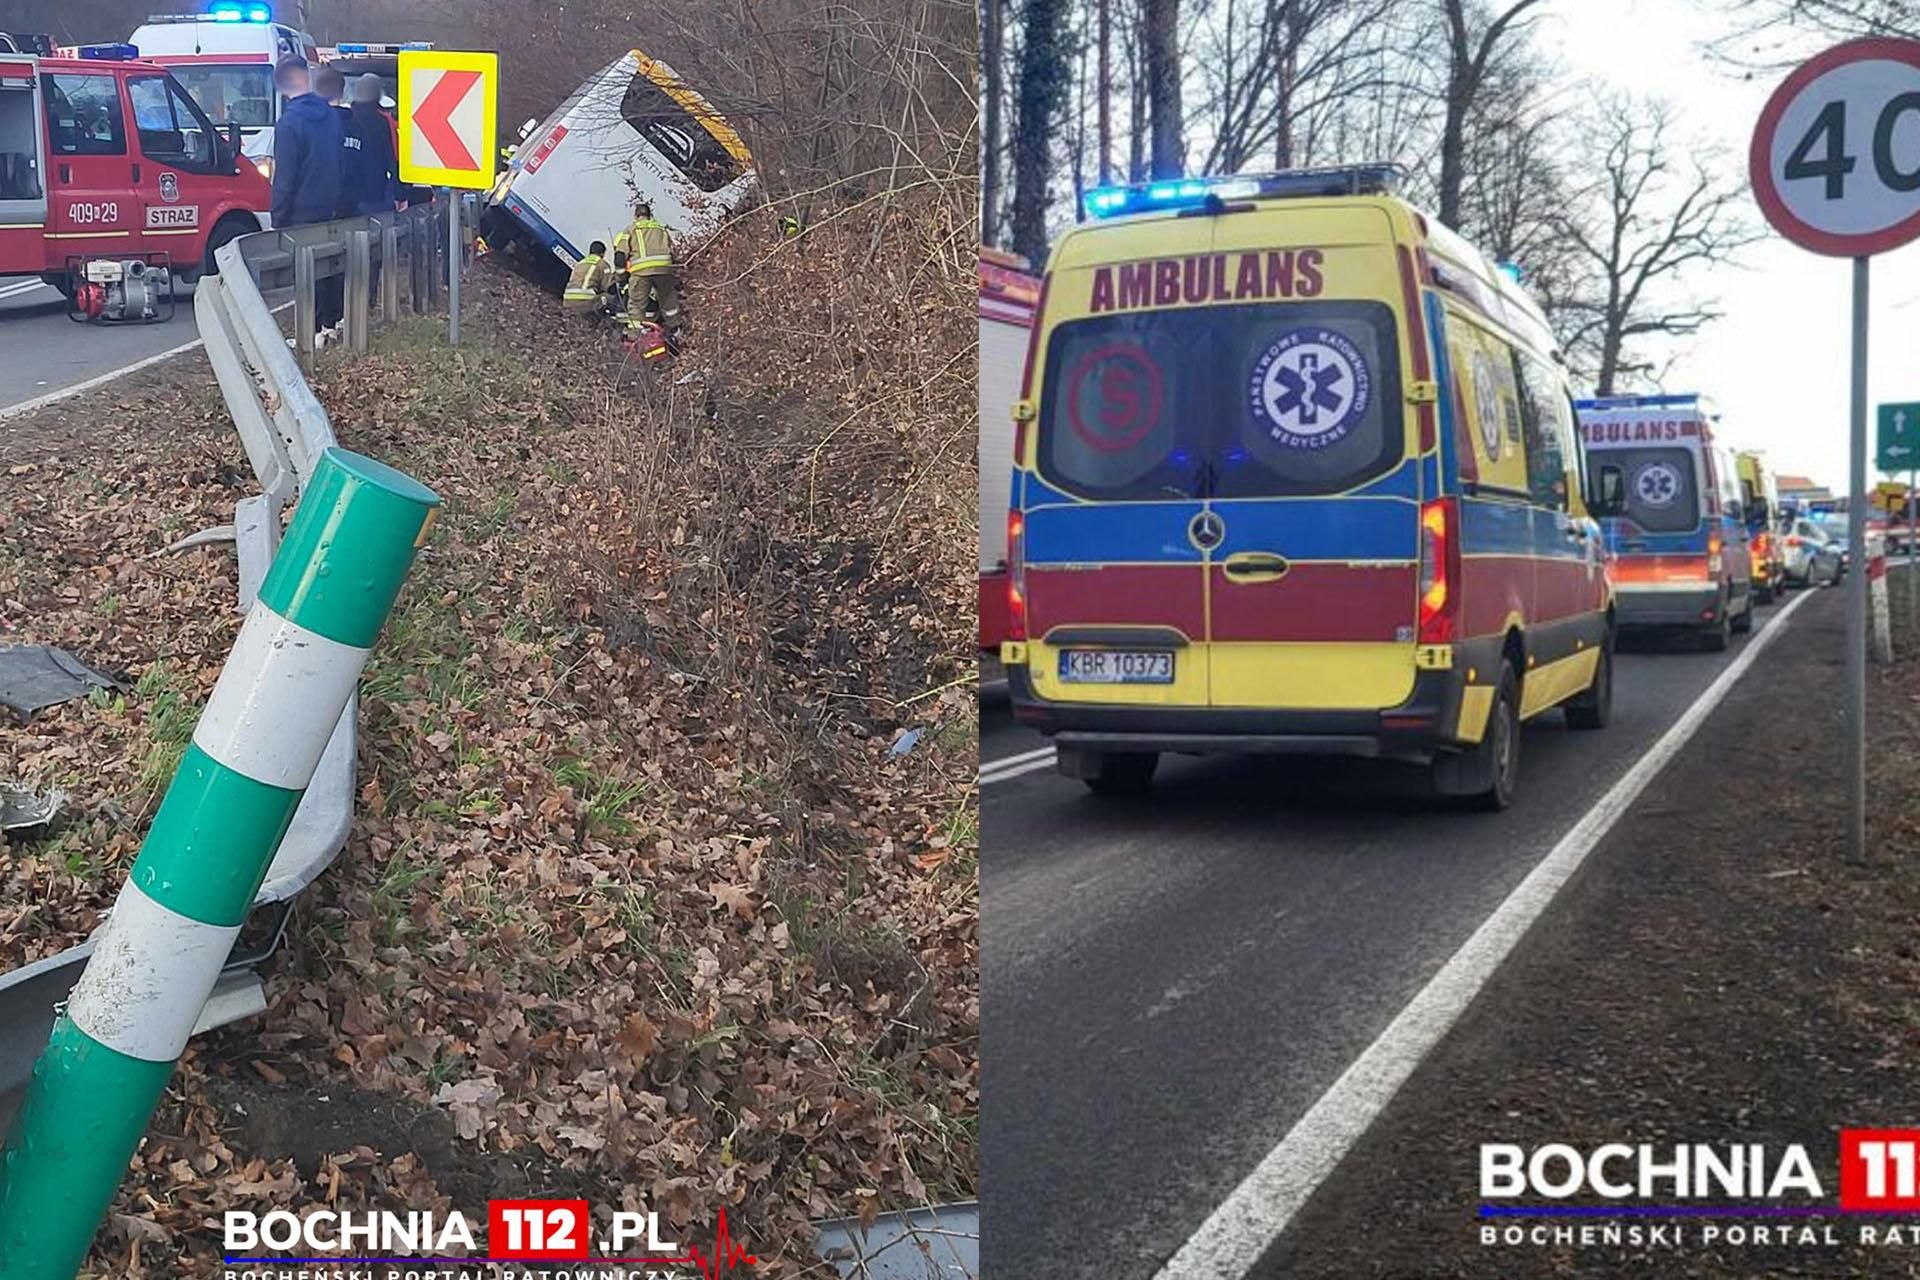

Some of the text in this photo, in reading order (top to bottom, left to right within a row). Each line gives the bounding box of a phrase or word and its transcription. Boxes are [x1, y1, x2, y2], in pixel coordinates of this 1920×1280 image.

[1784, 91, 1920, 200] 40
[1090, 249, 1324, 313] AMBULANS
[1101, 365, 1140, 428] S
[1270, 423, 1346, 448] MEDYCZNE
[1581, 421, 1677, 443] BULANS
[1070, 652, 1169, 676] KBR 10373
